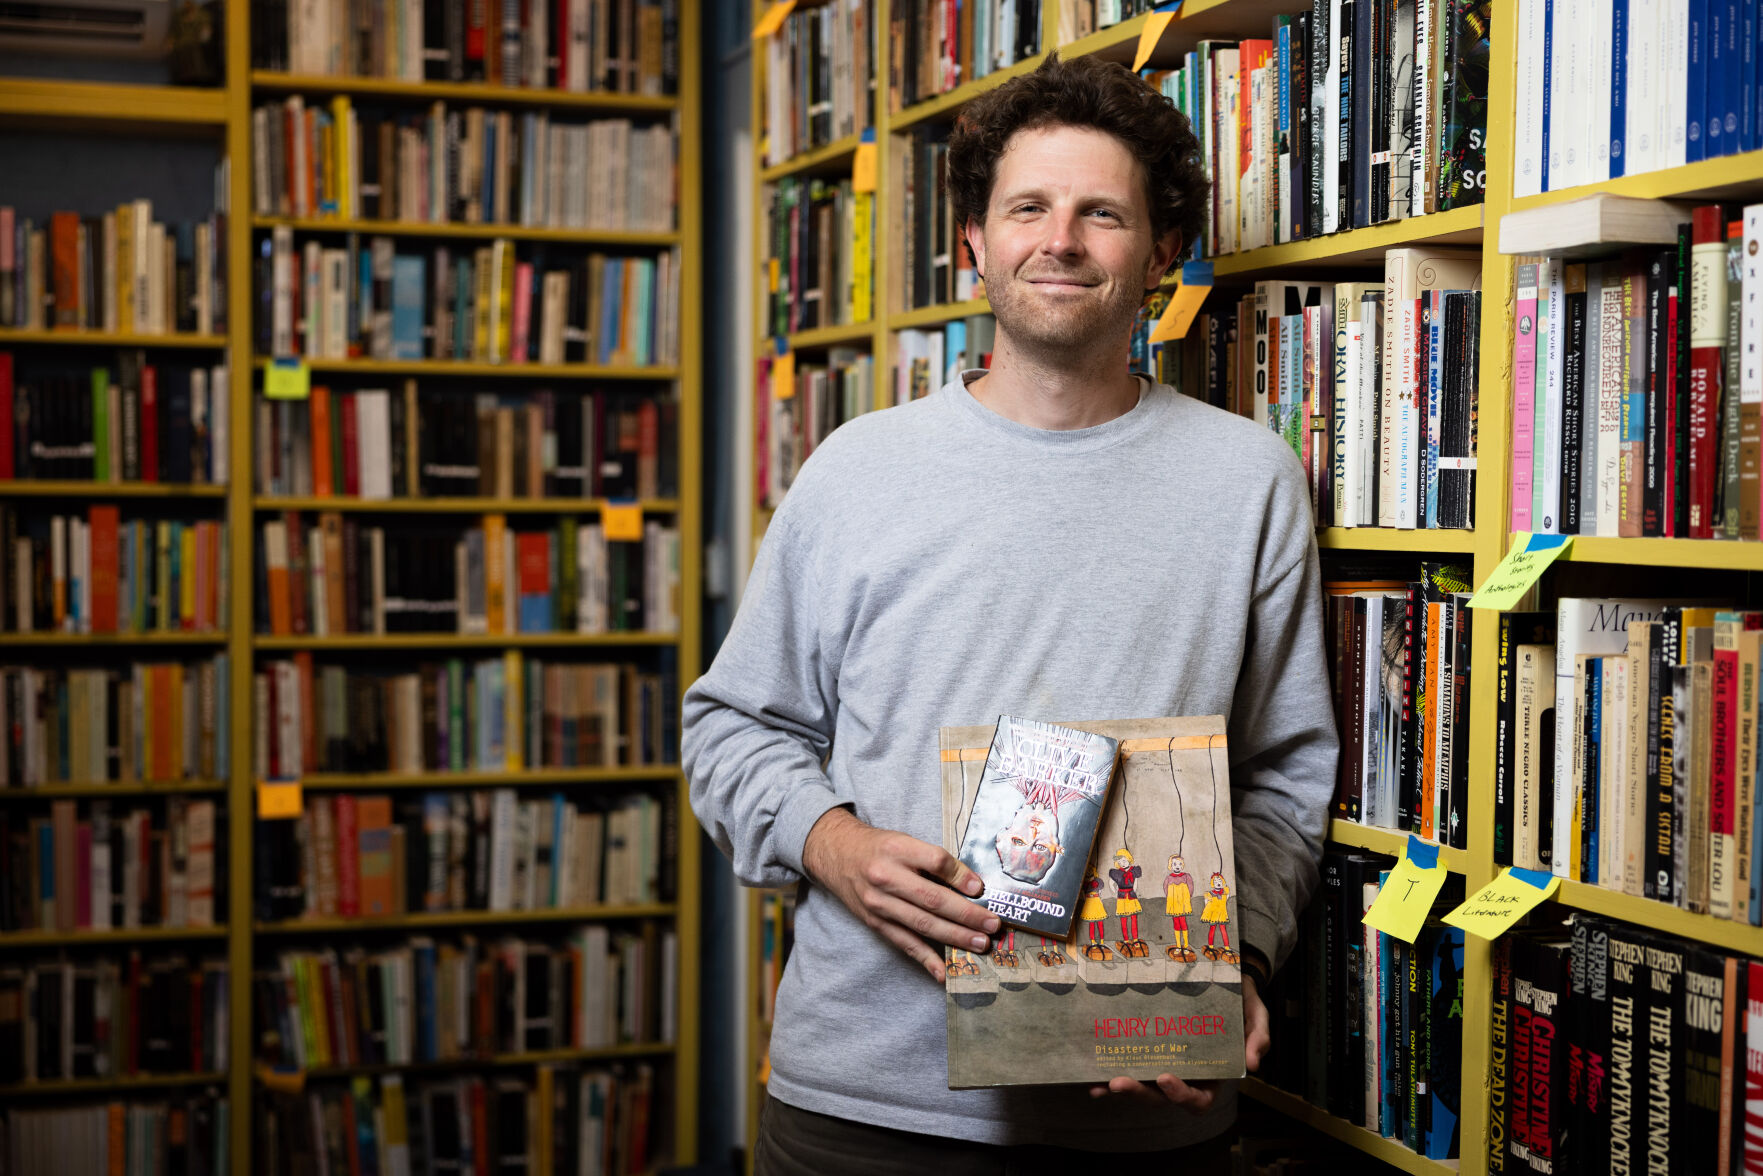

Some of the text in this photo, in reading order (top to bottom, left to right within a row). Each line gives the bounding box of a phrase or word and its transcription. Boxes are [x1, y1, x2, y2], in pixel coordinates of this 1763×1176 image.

[1426, 3, 1435, 34] Empty
[1339, 36, 1350, 162] Sayers THE NINE TAILORS
[1311, 107, 1321, 206] GEORGE SAUNDERS
[1424, 124, 1433, 173] Schweblin
[1651, 290, 1659, 307] The
[1403, 309, 1411, 345] ZADIE
[1574, 320, 1582, 346] BEST
[1209, 317, 1219, 390] ÖRÆFI
[1256, 310, 1267, 394] MOO
[1293, 320, 1301, 394] Ali Smith
[1402, 348, 1410, 384] SMITH
[1429, 325, 1440, 419] BLUE MOVIE
[1601, 316, 1611, 400] NONREQUIRED
[1610, 317, 1622, 400] AMERICAN
[1621, 277, 1632, 442] THE BEST AMERICAN NONREQUIRED READING
[1650, 331, 1658, 373] American
[1383, 276, 1395, 477] ZADIE SMITH ON BEAUTY
[1572, 350, 1580, 408] AMERICAN
[1647, 373, 1656, 427] Nonrequired
[1726, 300, 1741, 484] From the Flight Deck
[1335, 331, 1348, 481] ORAL HISTORY
[1419, 333, 1430, 517] MAGGIE'S GRAVE D SODERGREN
[1563, 355, 1573, 448] RICHARD RUSSO,
[1696, 367, 1707, 438] DONALD
[1401, 425, 1409, 477] AUTOGRAPH
[1571, 411, 1579, 448] SHORT
[1647, 428, 1656, 465] Reading
[1570, 450, 1578, 494] STORIES
[1619, 457, 1628, 484] DAVE
[1402, 590, 1413, 722] HIROSHIMA
[1443, 662, 1451, 671] A
[1662, 625, 1670, 662] FILES
[1668, 621, 1677, 667] LOLITA
[1442, 671, 1452, 725] SUMMONS
[1497, 619, 1510, 804] Swing Low Rebecca Carroll
[1441, 725, 1451, 739] TO
[1523, 706, 1531, 739] THREE
[1629, 657, 1640, 817] American Negro Short Stories
[1017, 739, 1095, 774] CLIVE
[1440, 740, 1450, 792] MEMPHIS
[1522, 742, 1531, 777] NEGRO
[1554, 696, 1566, 801] The Heart of Woman
[1738, 662, 1752, 882] HURSTON Their Eyes Were Watching God
[996, 755, 1101, 795] BARKER
[1657, 695, 1673, 855] SCENES FROM A SISTAH
[1712, 659, 1727, 892] SOUL BROTHERS AND SISTER LOU
[1521, 779, 1530, 828] CLASSICS
[986, 901, 1032, 923] HEART
[987, 888, 1066, 918] HELLBOUND
[1403, 879, 1420, 901] T
[1479, 890, 1521, 904] BLACK
[1571, 925, 1587, 995] STEPHEN
[1587, 941, 1596, 987] KING
[1589, 929, 1608, 1002] STEPHEN
[1609, 938, 1645, 967] STEPHEN
[1613, 961, 1634, 985] KING
[1646, 946, 1683, 976] STEPHEN
[1651, 969, 1672, 995] KING
[1685, 970, 1724, 999] STEPHEN
[1094, 1015, 1227, 1039] HENRY DARGER
[1392, 971, 1402, 1069] johnny got his gun
[1534, 998, 1553, 1016] KING
[1610, 996, 1634, 1037] THE
[1649, 1005, 1672, 1048] THE
[1684, 991, 1723, 1034] KING
[1095, 1043, 1188, 1055] Disasters of War
[1489, 999, 1508, 1172] THE DEAD ZONE
[1510, 1004, 1533, 1147] CHRISTINE
[1529, 1015, 1556, 1159] CHRISTINE
[1528, 1152, 1553, 1175] VIKING
